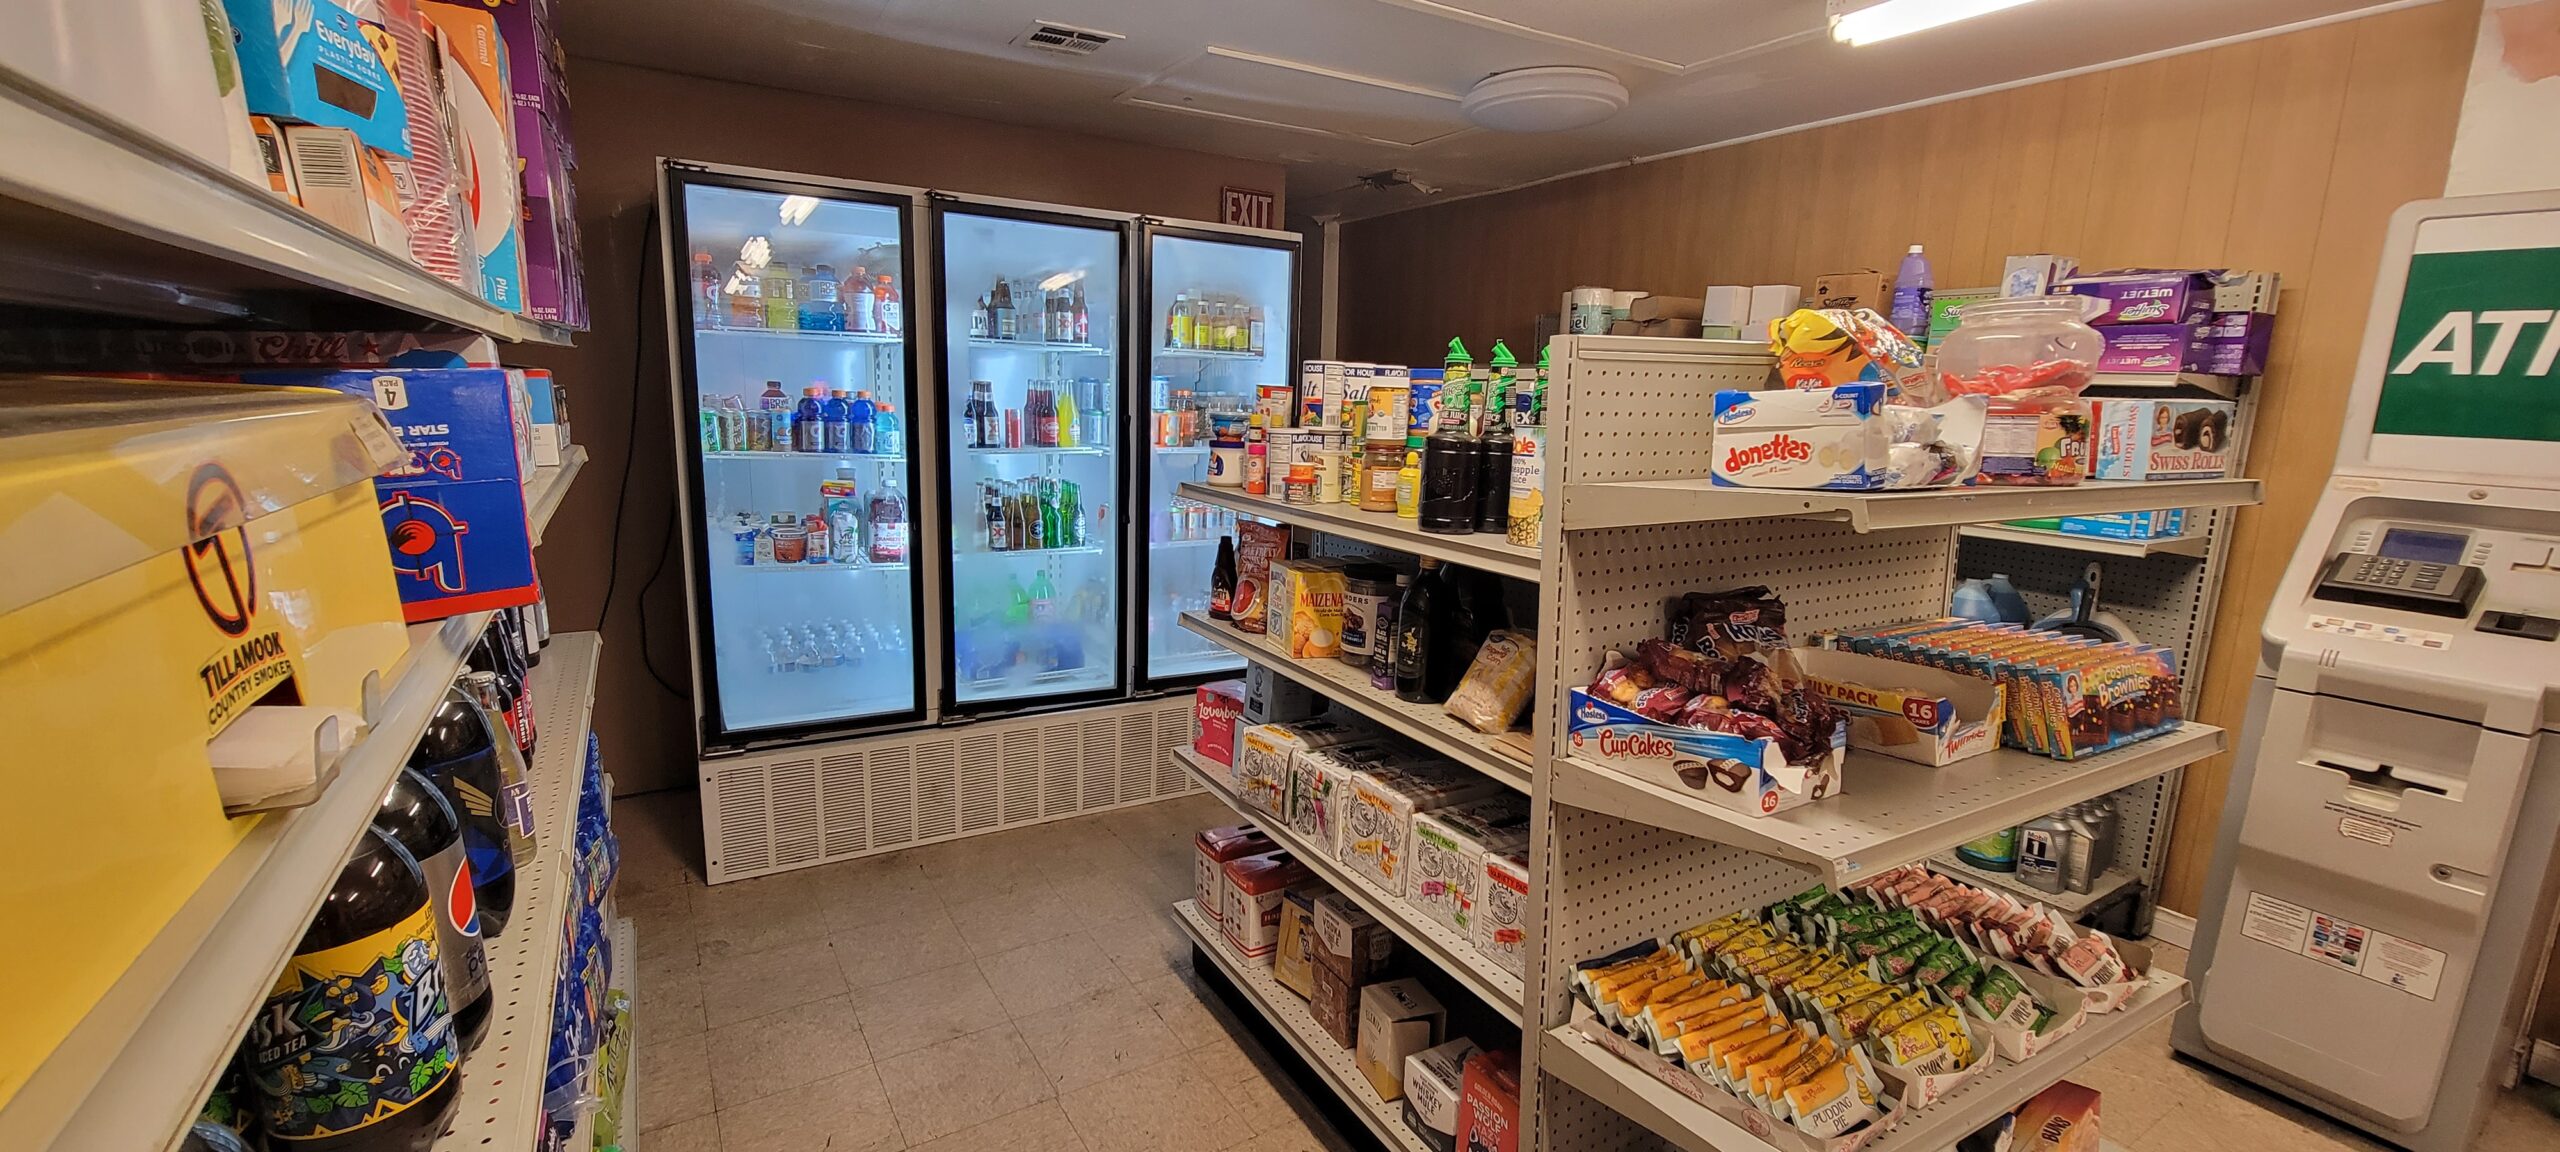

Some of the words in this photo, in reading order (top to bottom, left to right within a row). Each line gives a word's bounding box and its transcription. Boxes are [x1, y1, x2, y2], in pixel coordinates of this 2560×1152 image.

[315, 19, 377, 69] Everyday
[319, 45, 354, 68] PLASTIC
[1225, 191, 1272, 230] EXIT
[496, 277, 508, 304] Plus
[2121, 288, 2174, 299] WETJET
[2121, 302, 2170, 318] Swiffer
[257, 334, 348, 361] Chill
[378, 379, 399, 387] PACK
[385, 388, 397, 406] 4
[1450, 411, 1467, 420] JUICE
[1722, 408, 1754, 425] Hostess
[2127, 405, 2139, 440] SWISS
[408, 424, 450, 436] STAR
[1725, 434, 1812, 473] donettes
[2150, 452, 2189, 471] SWISS
[2191, 451, 2225, 470] ROLLS
[1512, 465, 1540, 477] eapple
[1513, 476, 1527, 484] uice
[1300, 593, 1344, 608] MAIZENA
[200, 632, 286, 698] TILLAMOOK
[2104, 661, 2141, 683] Cosmic
[208, 679, 252, 725] COUNTRY
[252, 660, 293, 692] SMOKER
[1837, 684, 1879, 707] PACK
[2098, 675, 2151, 707] Brownies
[1579, 706, 1607, 721] Hostess
[1908, 703, 1933, 719] 16
[2041, 681, 2057, 728] Brownies
[2052, 687, 2066, 722] Cosmic
[1910, 717, 1930, 726] CAKES
[1573, 734, 1583, 745] 16
[1599, 729, 1675, 759] CupCakes
[1945, 730, 1988, 758] Twinkies
[1764, 795, 1777, 808] 16
[1419, 826, 1441, 844] VARIETY
[1441, 837, 1457, 850] PACK
[2028, 831, 2048, 843] Mobil
[2031, 840, 2040, 855] 1
[1490, 869, 1514, 887] VARIETY
[1515, 882, 1528, 894] PAC
[259, 1048, 280, 1065] ICED
[283, 1037, 307, 1059] TEA
[1914, 1056, 1944, 1077] LEMON
[1412, 1077, 1442, 1112] WHISKEY
[1417, 1093, 1435, 1116] MULE
[1466, 1093, 1509, 1131] PASSION
[1473, 1107, 1501, 1134] WOLF
[1812, 1096, 1853, 1127] PUDDING
[1832, 1114, 1850, 1132] PIE
[2041, 1115, 2072, 1144] BUNS
